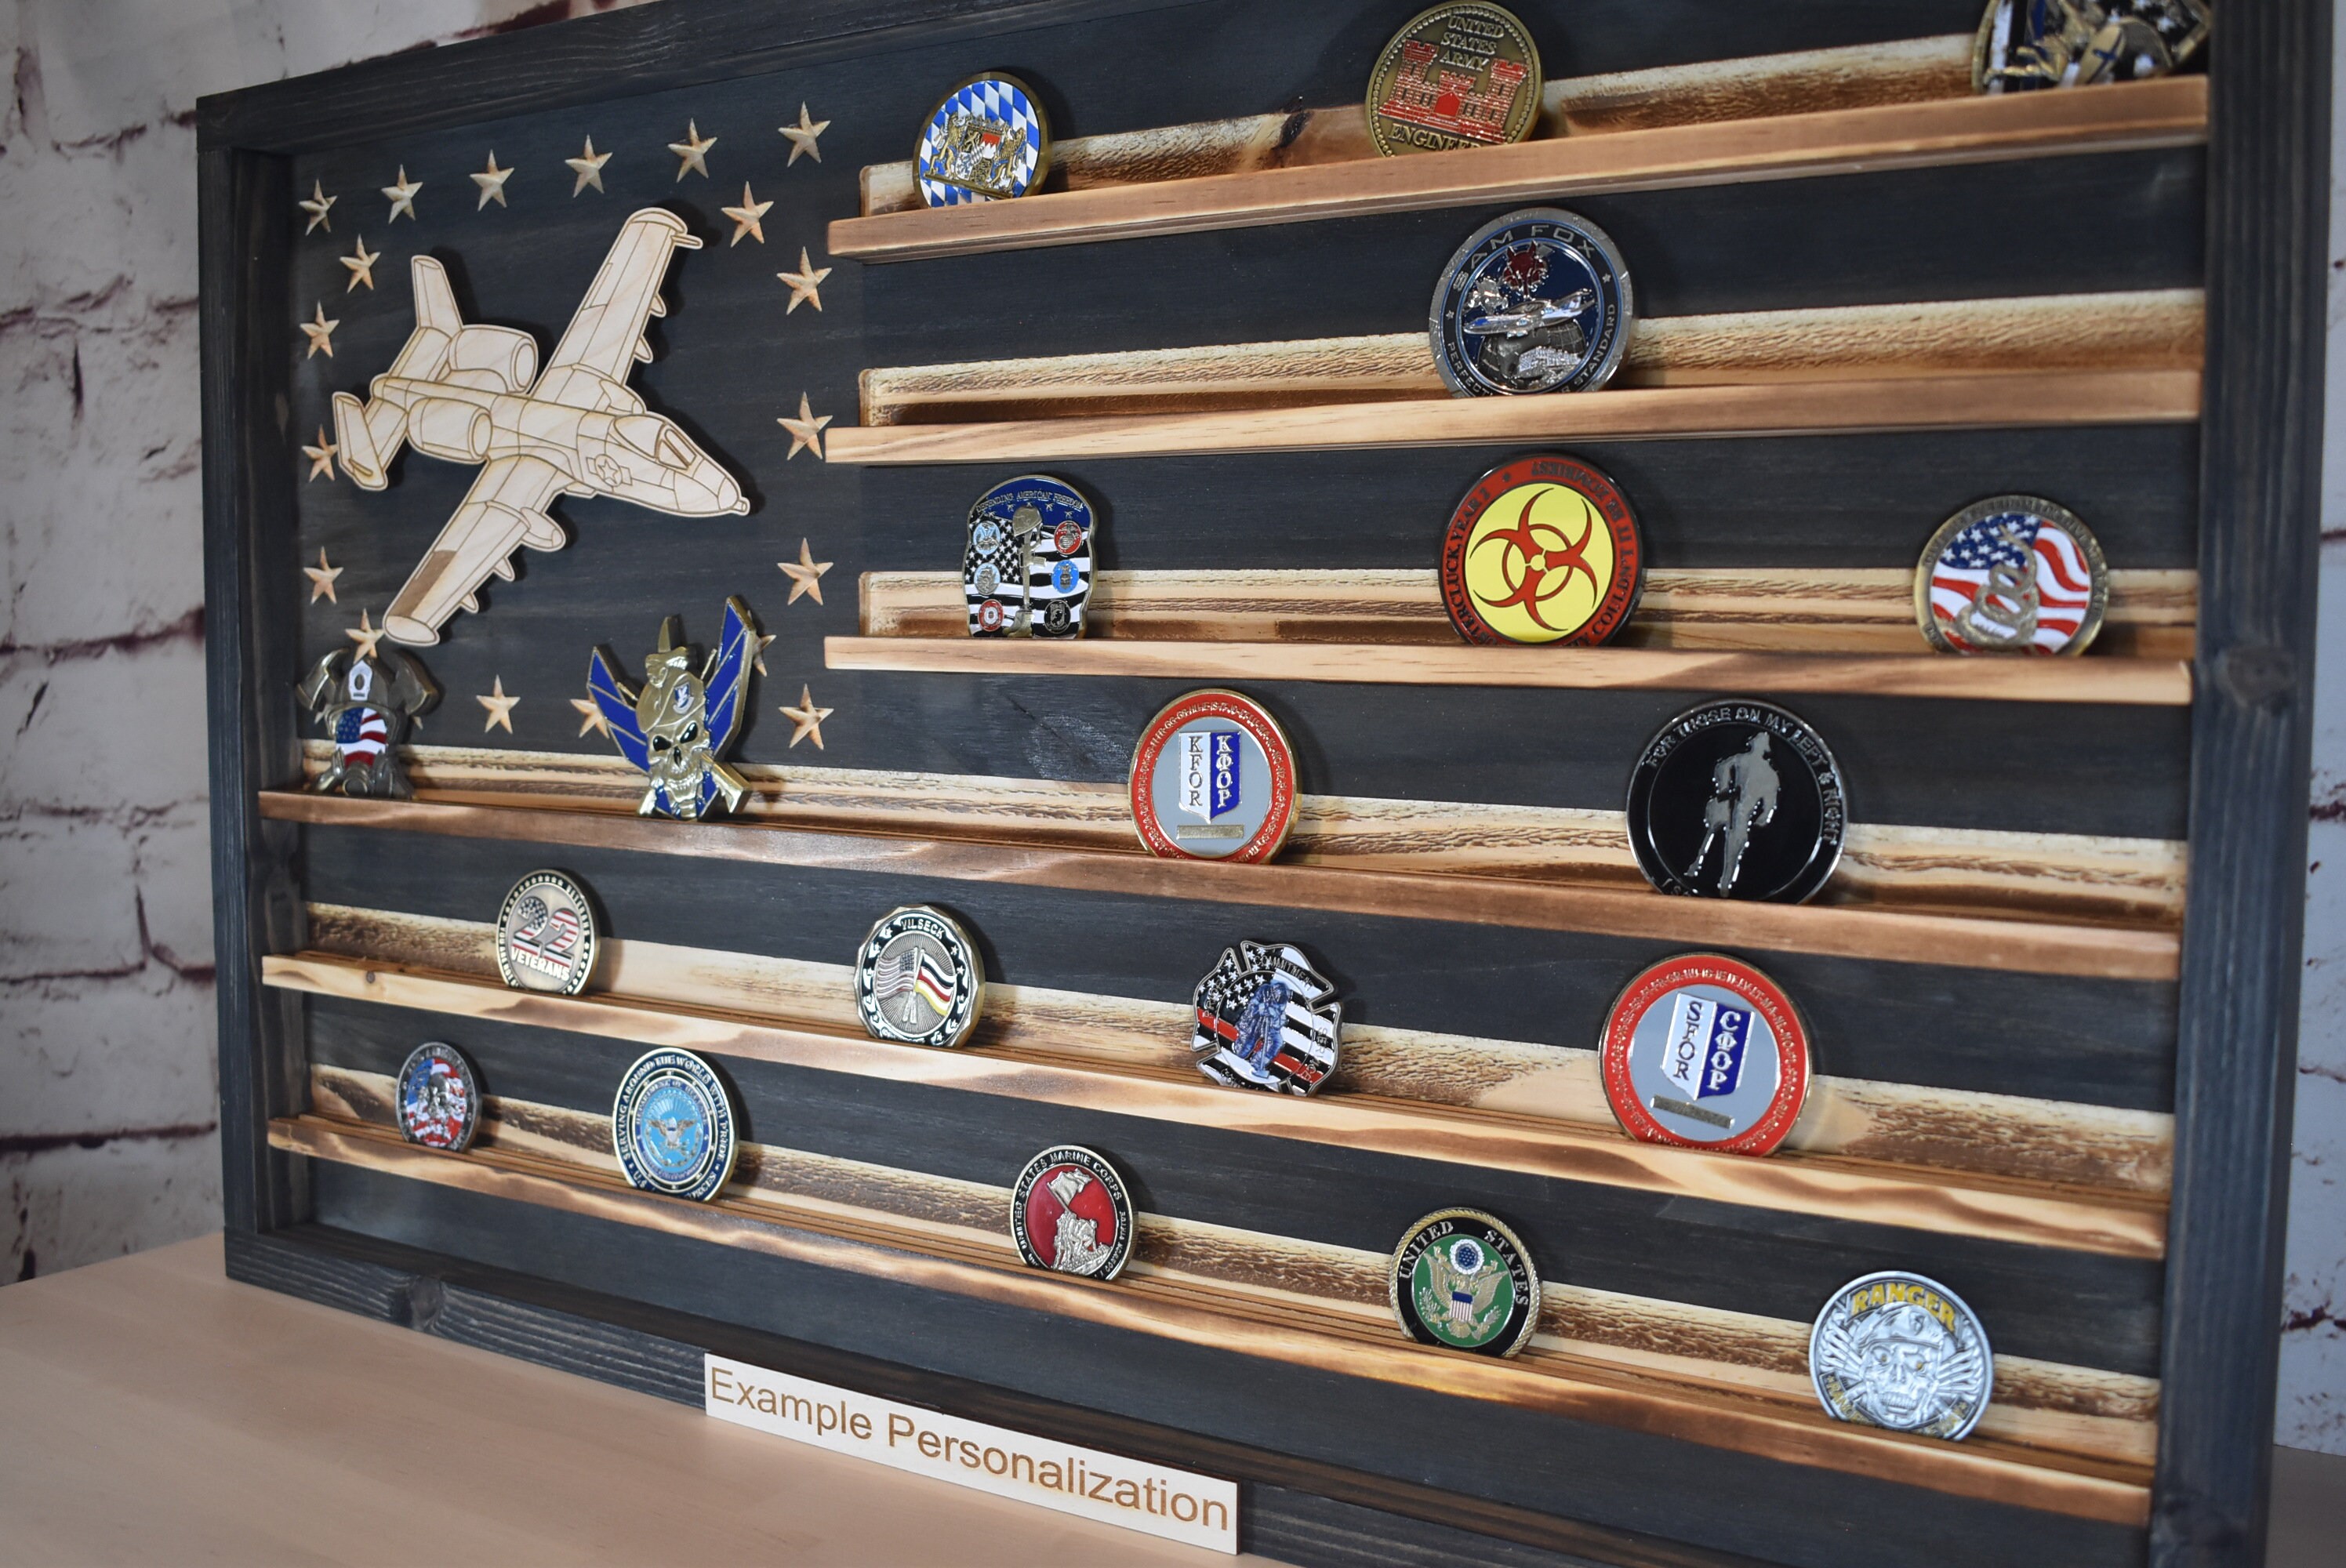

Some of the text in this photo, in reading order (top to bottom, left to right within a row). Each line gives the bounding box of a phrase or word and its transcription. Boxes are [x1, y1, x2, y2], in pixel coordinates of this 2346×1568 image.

[1440, 31, 1497, 56] STATES
[1447, 16, 1505, 38] UNITED
[1440, 50, 1489, 71] ARMY
[1452, 225, 1595, 292] SAM FOX
[1574, 304, 1615, 386] STANDARD
[975, 490, 1084, 514] DEFENDING AMERICAN FREEDOM
[1617, 525, 1633, 543] IT
[1189, 735, 1203, 806] KFOR
[1646, 735, 1676, 768] FOR
[1673, 707, 1731, 738] THOSE
[1735, 707, 1762, 724] ON
[1766, 713, 1793, 733] MY
[1788, 728, 1828, 765] LEFT
[1822, 787, 1842, 846] RIGHT
[901, 918, 946, 938] VILSECK
[511, 946, 571, 981] VETERANS
[1254, 955, 1314, 991] COMMITMENT
[1672, 1000, 1702, 1081] SFOR
[618, 1054, 728, 1162] SERVING AROUND THE WORLD WITH PRIDE
[1014, 1150, 1122, 1250] UNITED STATES MARINE CORPS
[1399, 1221, 1529, 1306] UNITED STATES
[1850, 1283, 1956, 1333] RANGER
[710, 1366, 1229, 1531] Example Personalization
